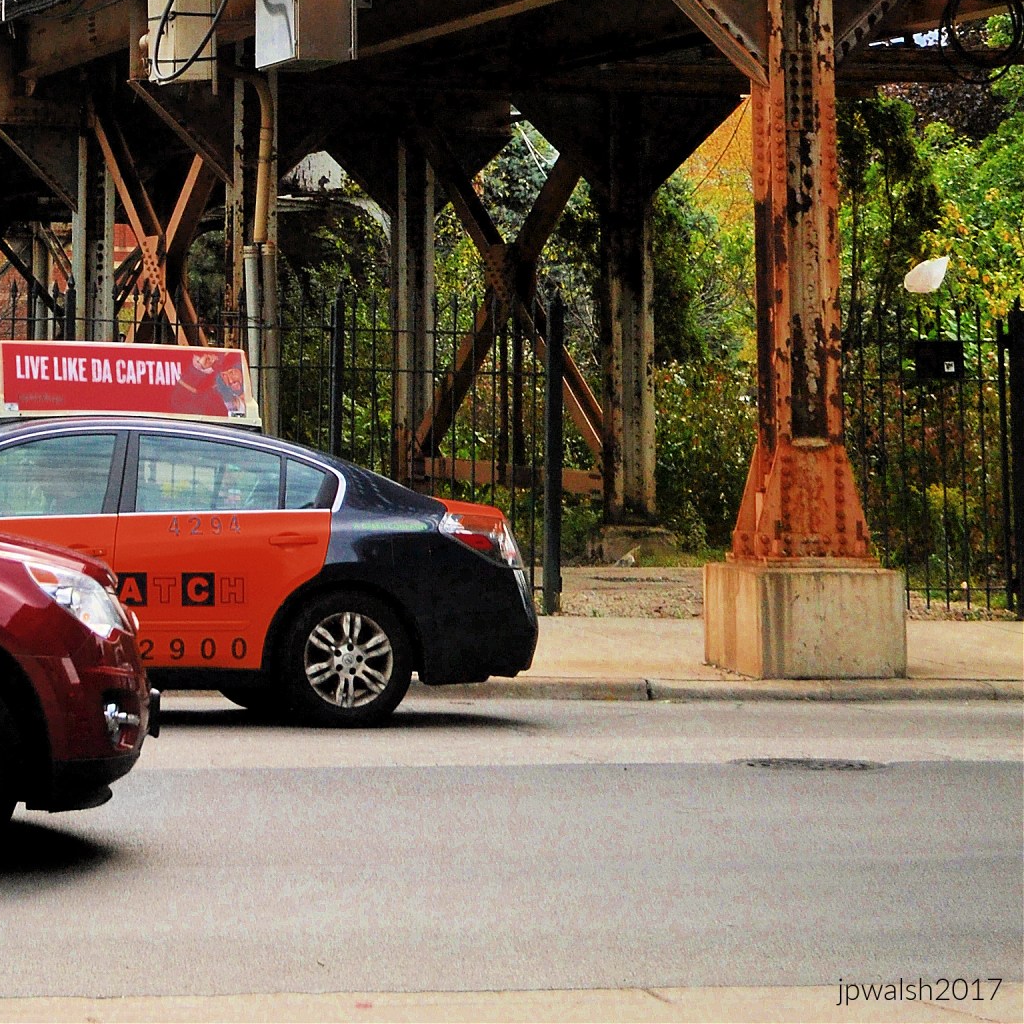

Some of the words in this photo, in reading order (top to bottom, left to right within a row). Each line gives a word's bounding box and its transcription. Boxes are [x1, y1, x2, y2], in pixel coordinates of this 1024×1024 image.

[16, 355, 49, 380] LIVE
[53, 356, 87, 382] LIKE
[91, 358, 113, 383] DA
[116, 359, 182, 386] CAPTAIN
[168, 514, 241, 536] 4294
[139, 637, 248, 660] 2900
